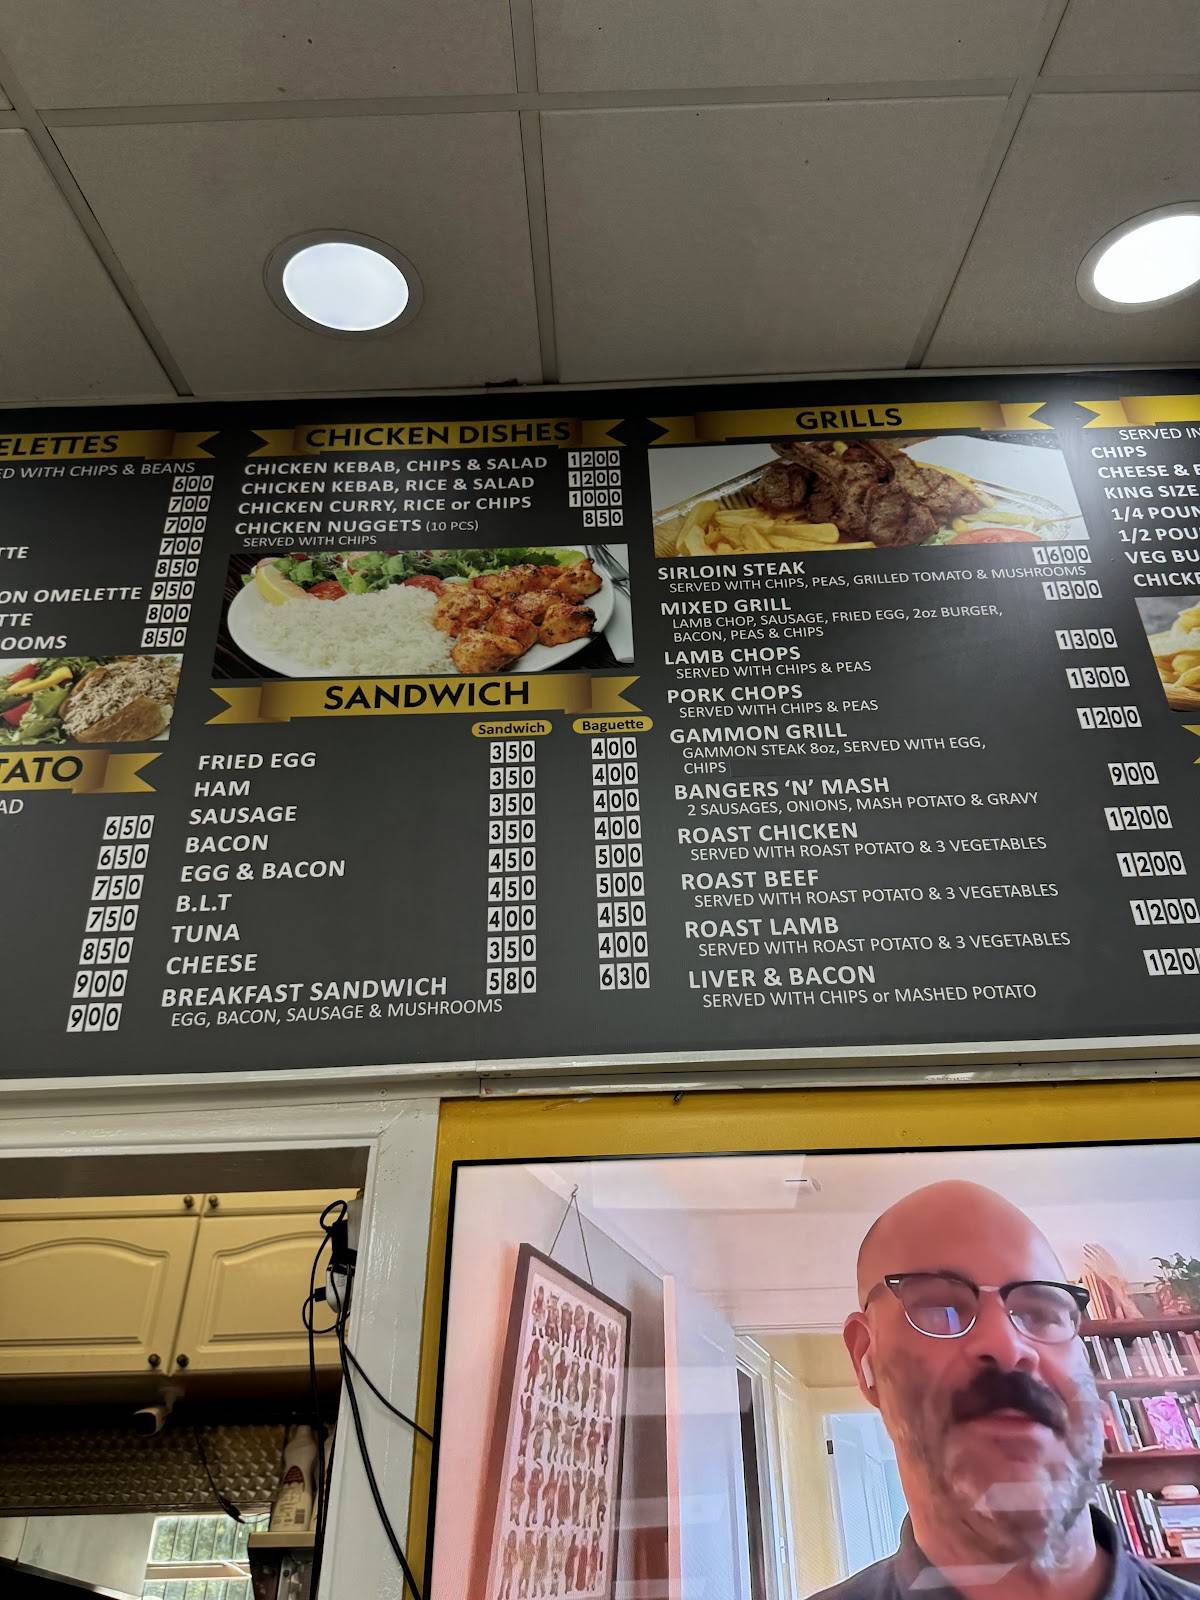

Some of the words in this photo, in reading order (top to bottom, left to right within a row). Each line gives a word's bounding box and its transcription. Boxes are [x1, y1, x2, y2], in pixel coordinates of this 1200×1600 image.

[795, 408, 902, 430] GRILLS
[304, 426, 450, 448] CHICKEN
[459, 422, 572, 446] DISHES
[570, 452, 619, 466] 1200
[1091, 446, 1147, 458] CHIPS
[21, 466, 65, 478] WITH
[70, 464, 118, 476] CHIPS
[122, 464, 134, 475] &
[141, 462, 194, 474] BEANS
[244, 462, 327, 475] CHICKEN
[334, 461, 400, 474] KEBAB,
[406, 460, 461, 472] CHIPS
[467, 459, 481, 470] &
[487, 457, 547, 470] SALAD
[1098, 465, 1170, 479] CHEESE
[1173, 464, 1190, 476] &
[174, 477, 213, 490] 600
[571, 471, 620, 486] 1200
[572, 490, 621, 505] 1000
[1104, 486, 1154, 500] KING
[1158, 484, 1200, 498] SIZE
[170, 497, 210, 511] 700
[238, 501, 323, 514] CHICKEN
[330, 500, 397, 514] CURRY,
[404, 499, 445, 511] RICE
[451, 501, 471, 510] or
[476, 496, 531, 510] CHIPS
[584, 511, 622, 525] 850
[1111, 506, 1144, 522] 1/4
[235, 521, 321, 535] CHICKEN
[328, 519, 422, 533] NUGGETS
[426, 521, 446, 532] (10
[450, 520, 478, 532] PCS)
[1118, 528, 1152, 544] 1/2
[1036, 547, 1089, 562] 1600
[1124, 550, 1167, 564] VEG
[658, 564, 736, 580] SIRLOIN
[743, 561, 805, 576] STEAK
[670, 582, 721, 593] SERVED
[724, 580, 761, 590] WITH
[765, 578, 808, 589] CHIPS,
[812, 576, 850, 587] PEAS,
[853, 573, 909, 585] GRILLED
[912, 570, 972, 582] TOMATO
[976, 569, 988, 580] &
[991, 566, 1086, 578] MUSHROOMS
[34, 587, 142, 603] OMELETTE
[154, 582, 193, 598] 950
[1046, 582, 1100, 598] 1300
[661, 600, 728, 615] MIXED
[734, 598, 792, 612] GRILL
[673, 618, 712, 628] LAMB
[716, 616, 756, 627] CHOP,
[760, 612, 828, 625] SAUSAGE,
[832, 610, 872, 622] FRIED
[876, 609, 909, 621] EGG,
[912, 608, 938, 618] 2oz
[940, 605, 1002, 617] BURGER,
[144, 629, 185, 645] 850
[674, 631, 726, 642] BACON,
[731, 629, 764, 640] PEAS
[768, 628, 780, 638] &
[784, 626, 824, 638] CHIPS
[664, 650, 724, 665] LAMB
[730, 646, 800, 662] CHOPS
[676, 667, 730, 679] SERVED
[733, 665, 772, 676] WITH
[776, 663, 817, 675] CHIPS
[821, 662, 832, 673] &
[836, 660, 872, 672] PEAS
[1070, 669, 1126, 686] 1300
[324, 680, 529, 710] SANDWICH
[668, 688, 725, 704] PORK
[731, 684, 802, 701] CHOPS
[582, 718, 645, 734] Baguette
[1082, 709, 1138, 726] 1200
[478, 721, 546, 736] Sandwich
[670, 725, 779, 744] GAMMON
[786, 722, 848, 739] GRILL
[492, 743, 534, 760] 350
[592, 740, 635, 757] 400
[682, 745, 757, 759] GAMMON
[761, 743, 806, 756] STEAK
[810, 742, 840, 755] 8oz,
[844, 740, 900, 752] SERVED
[904, 738, 945, 750] WITH
[949, 736, 986, 750] EGG,
[198, 754, 263, 770] FRIED
[270, 752, 316, 768] EGG
[684, 762, 726, 774] CHIPS
[1111, 764, 1156, 783] 900
[194, 780, 250, 797] HAM
[674, 781, 779, 800] BANGERS
[822, 777, 889, 795] MASH
[688, 804, 696, 816] 2
[700, 801, 782, 816] SAUSAGES,
[786, 798, 852, 812] ONIONS,
[856, 797, 902, 810] MASH
[907, 794, 966, 808] POTATO
[970, 794, 984, 806] &
[987, 792, 1038, 806] GRAVY
[189, 806, 297, 825] SAUSAGE
[106, 818, 152, 836] 650
[678, 826, 752, 844] ROAST
[759, 822, 858, 842] CHICKEN
[185, 834, 268, 853] BACON
[690, 847, 749, 861] SERVED
[752, 845, 795, 858] WITH
[800, 843, 850, 857] ROAST
[854, 841, 914, 856] POTATO
[920, 840, 933, 853] &
[936, 840, 946, 852] 3
[949, 836, 1047, 852] VEGETABLES
[490, 850, 534, 870] 450
[598, 846, 641, 866] 500
[180, 864, 230, 882] EGG
[236, 863, 254, 880] &
[262, 860, 345, 880] BACON
[681, 871, 757, 890] ROAST
[764, 869, 818, 888] BEEF
[94, 878, 141, 897] 750
[176, 894, 232, 912] B.L.T
[1135, 902, 1197, 922] 1200
[488, 908, 535, 928] 400
[599, 904, 644, 924] 450
[171, 924, 240, 943] TUNA
[685, 919, 762, 938] ROAST
[770, 916, 839, 936] LAMB
[82, 940, 130, 961] 850
[489, 938, 535, 960] 350
[599, 934, 646, 955] 400
[166, 954, 258, 975] CHEESE
[1149, 952, 1200, 972] 120
[76, 973, 125, 994] 900
[488, 970, 535, 991] 580
[601, 966, 648, 987] 630
[689, 969, 756, 988] LIVER
[763, 968, 782, 986] &
[789, 965, 876, 986] BACON
[161, 983, 304, 1007] BREAKFAST
[310, 977, 446, 1001] SANDWICH
[703, 992, 766, 1008] SERVED
[770, 991, 815, 1006] WITH
[820, 989, 868, 1004] CHIPS
[872, 992, 890, 1003] or
[894, 986, 968, 1002] MASHED
[972, 984, 1036, 1000] POTATO
[71, 1006, 119, 1028] 900
[171, 1012, 210, 1028] EGG,
[217, 1009, 280, 1025] BACON,
[286, 1004, 364, 1022] SAUSAGE
[369, 1004, 382, 1018] &
[388, 998, 502, 1017] MUSHROOMS
